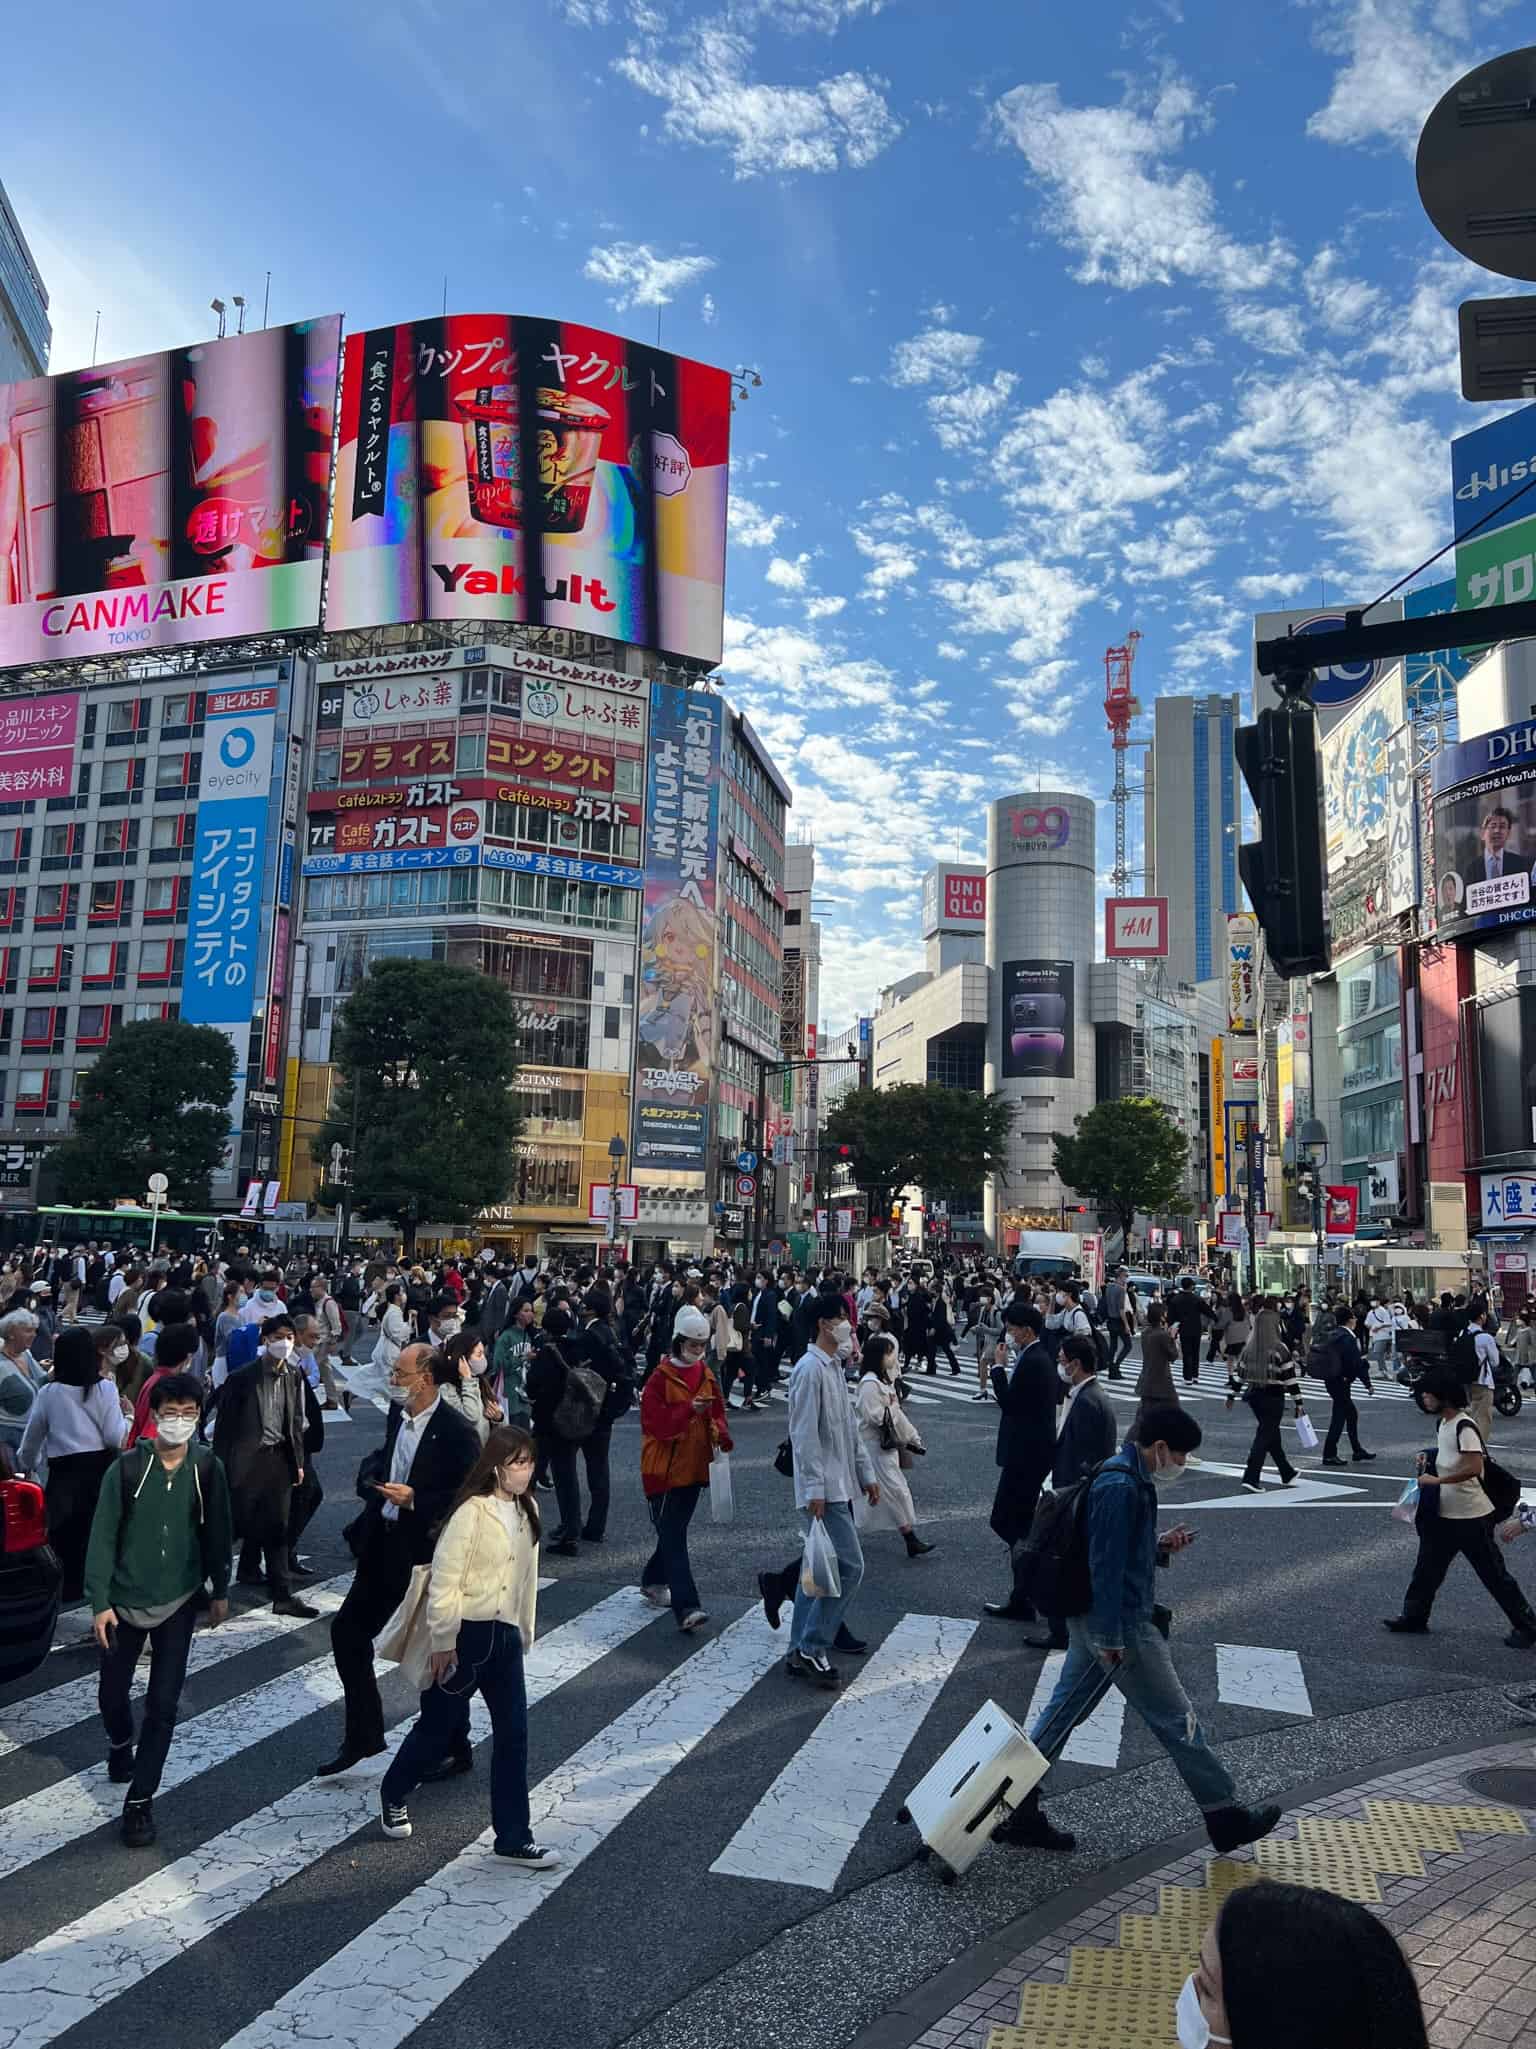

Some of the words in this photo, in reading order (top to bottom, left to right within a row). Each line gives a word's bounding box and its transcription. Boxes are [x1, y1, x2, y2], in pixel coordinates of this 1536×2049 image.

[431, 563, 617, 612] Yakult
[1467, 552, 1536, 609] サロ
[42, 582, 229, 637] CANMAKE
[108, 627, 152, 646] TOKYO
[334, 650, 453, 678] しゃぶしゃぶバイキング
[513, 652, 643, 692] しゃぶしゃぶバイキング
[213, 692, 270, 711] 当ビル5F
[321, 699, 342, 715] 9F
[384, 680, 452, 710] しゃぶ葉
[6, 705, 72, 727] 品川スキン
[566, 692, 641, 729] しゃぶ葉
[4, 724, 63, 745] クリニック
[1487, 727, 1536, 762] DH
[344, 741, 449, 773] プライス
[488, 740, 610, 782] コンタクト
[0, 766, 65, 791] 美容外科
[208, 771, 262, 788] eyecity
[406, 782, 461, 807] ガスト
[574, 798, 630, 825] ガスト
[311, 826, 336, 845] 7F
[342, 824, 371, 838] Café
[372, 815, 441, 849] ガスト
[1008, 806, 1071, 849] 109
[350, 850, 449, 870] 英会話イーオン
[535, 856, 641, 884] 英会話イーオン
[950, 879, 981, 897] UNI
[194, 829, 232, 988] アイシティ
[224, 827, 257, 986] コンタクトの
[950, 898, 983, 916] QLO
